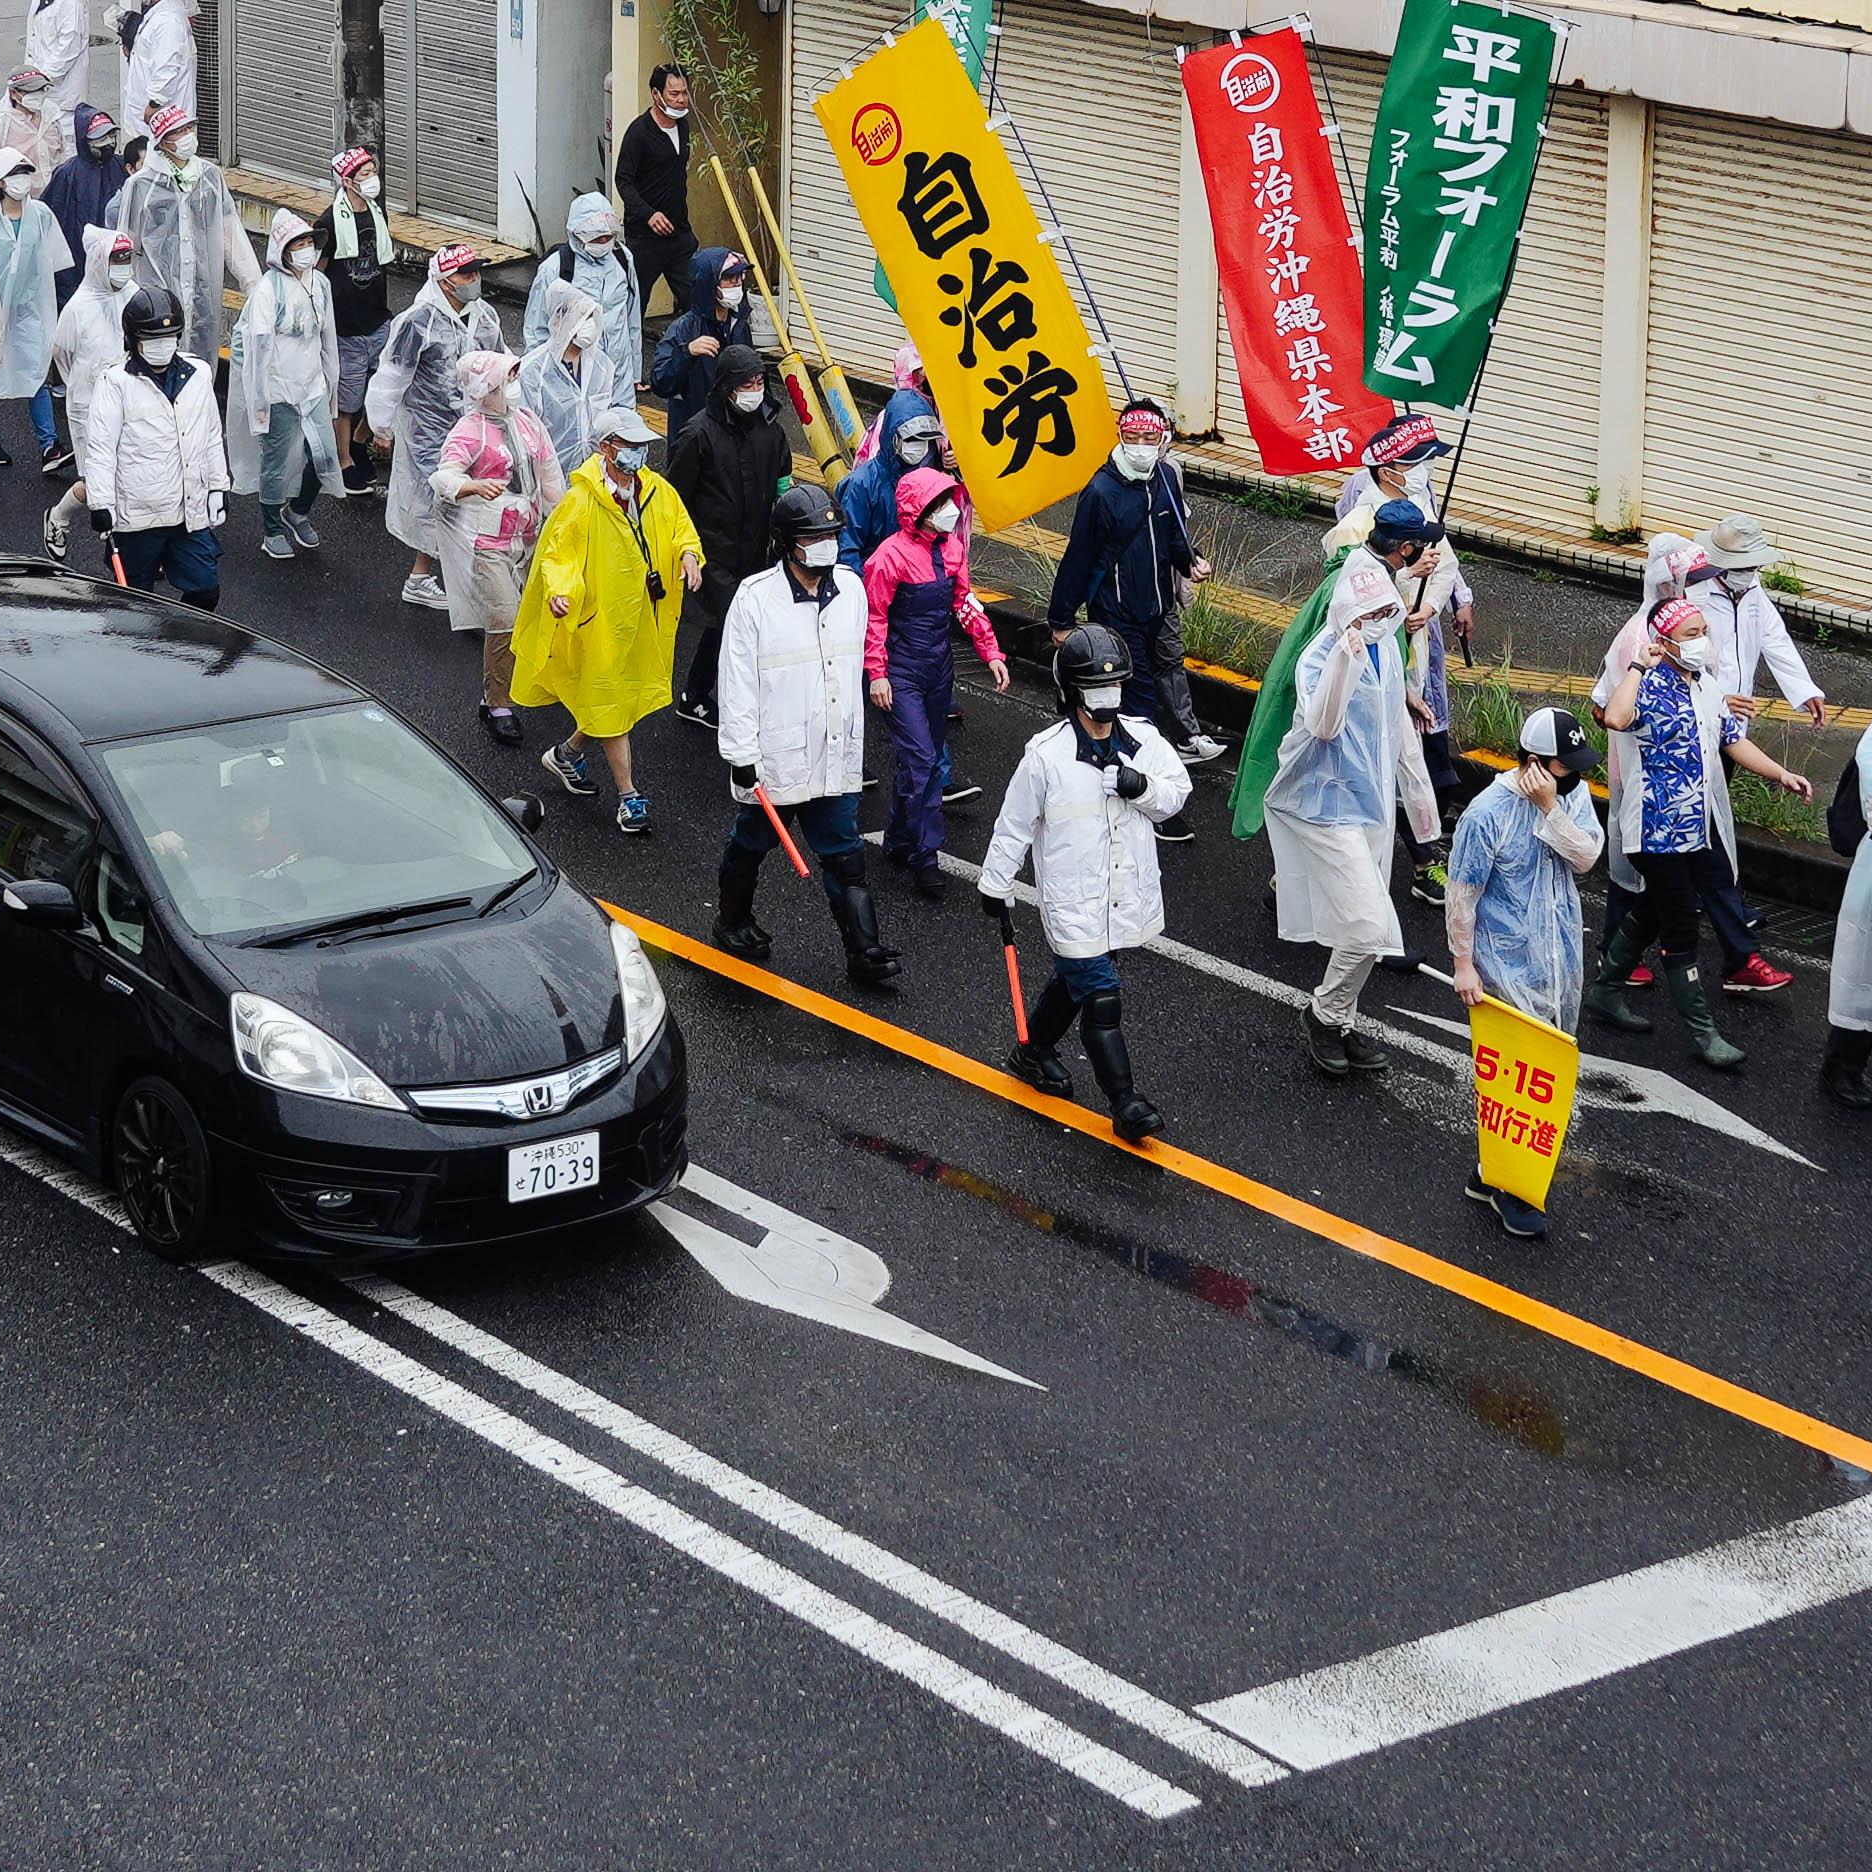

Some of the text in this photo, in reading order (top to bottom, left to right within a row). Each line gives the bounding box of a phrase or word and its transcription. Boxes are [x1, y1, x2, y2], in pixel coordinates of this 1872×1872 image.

[897, 150, 1078, 479] 自治労
[1247, 121, 1355, 464] 自治労沖縄県本部
[1400, 23, 1522, 388] 平和フォーラム
[514, 1155, 595, 1194] せ 70-39
[1474, 1091, 1559, 1158] 和行進
